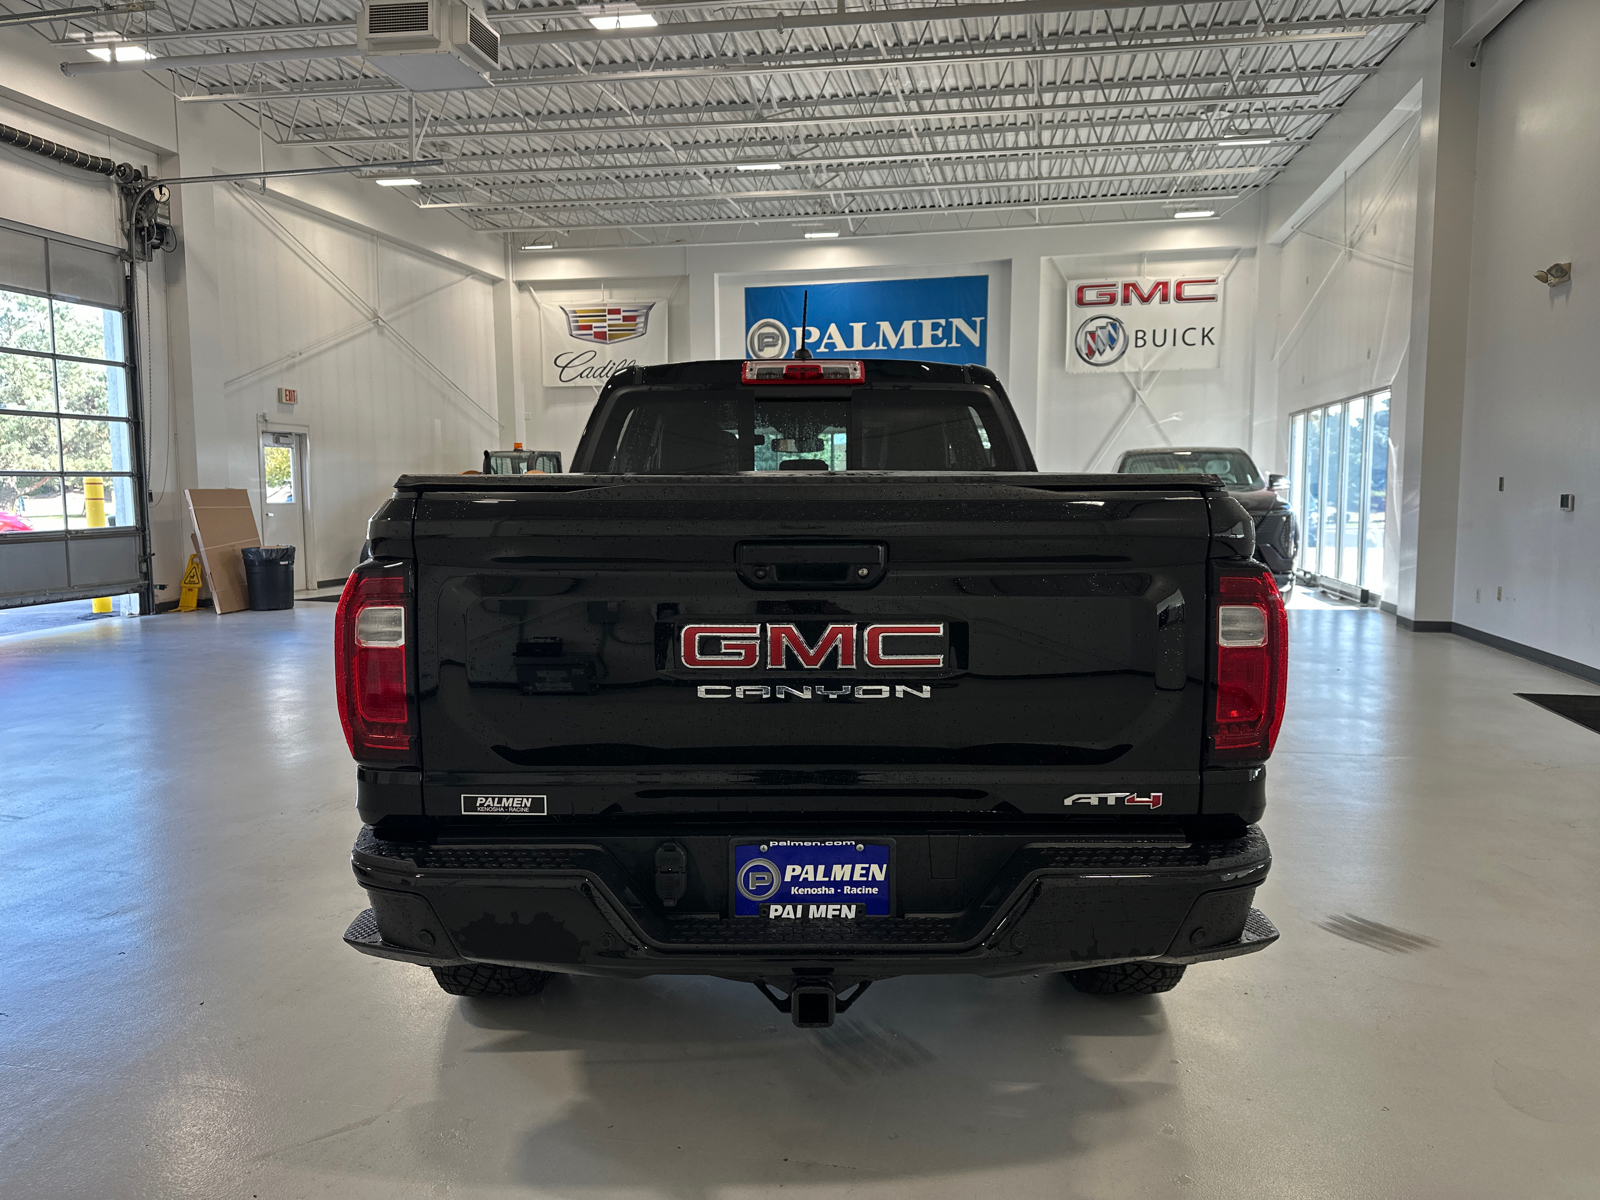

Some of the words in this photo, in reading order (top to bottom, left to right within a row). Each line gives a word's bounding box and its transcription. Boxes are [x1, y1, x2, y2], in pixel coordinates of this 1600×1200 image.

[1075, 277, 1218, 308] GMC
[792, 317, 985, 356] PALMEN
[1134, 327, 1215, 348] BUICK
[681, 623, 944, 669] GMC
[697, 685, 931, 699] CANYON
[476, 797, 532, 807] PALMEN
[1063, 792, 1163, 809] AT4
[784, 864, 887, 882] PALMEN
[791, 886, 835, 895] Kenosha
[843, 885, 879, 894] Racine
